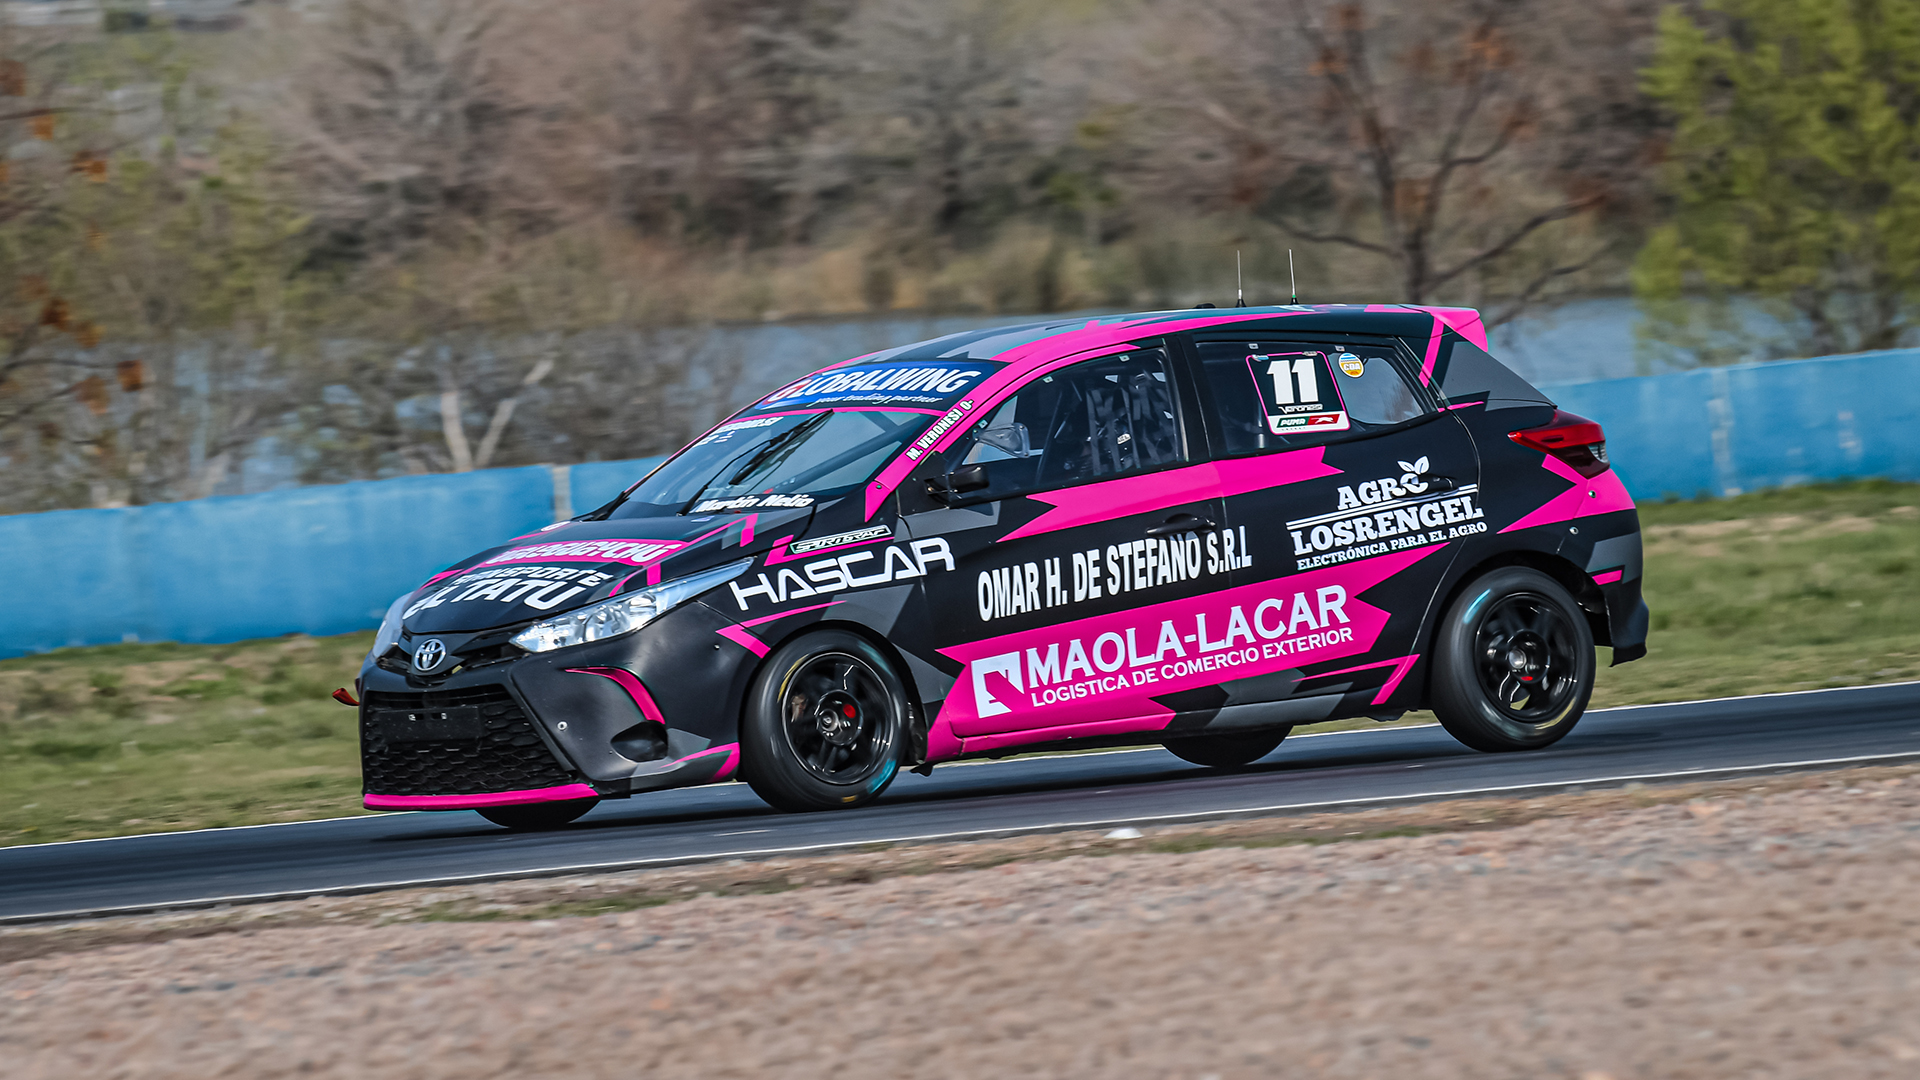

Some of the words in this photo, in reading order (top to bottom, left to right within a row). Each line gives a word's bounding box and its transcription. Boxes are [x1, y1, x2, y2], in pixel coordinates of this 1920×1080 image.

[764, 368, 982, 403] GLOBALWING
[1266, 358, 1319, 405] 11
[906, 447, 924, 461] M.
[916, 408, 965, 450] VERONESI
[1280, 418, 1306, 426] PUMA
[1337, 472, 1429, 511] AGRO
[1290, 496, 1485, 556] LOSRENGEL
[1296, 544, 1390, 571] ELECTRÓNICA
[1391, 534, 1428, 551] PARA
[1429, 528, 1447, 542] EL
[1448, 521, 1488, 539] AGRO
[450, 578, 587, 611] TATU
[728, 537, 956, 611] HASCAR
[977, 560, 1041, 622] OMAR
[1045, 556, 1068, 609] H.
[1072, 547, 1102, 602] DE
[1105, 531, 1202, 596] STEFANO
[1206, 526, 1253, 575] S.R.L
[1026, 584, 1352, 689] MAOLA-LACAR
[1031, 674, 1131, 708] LOGISTICA
[1134, 668, 1159, 687] DE
[1161, 646, 1260, 680] COMERCIO
[1263, 626, 1354, 660] EXTERIOR
